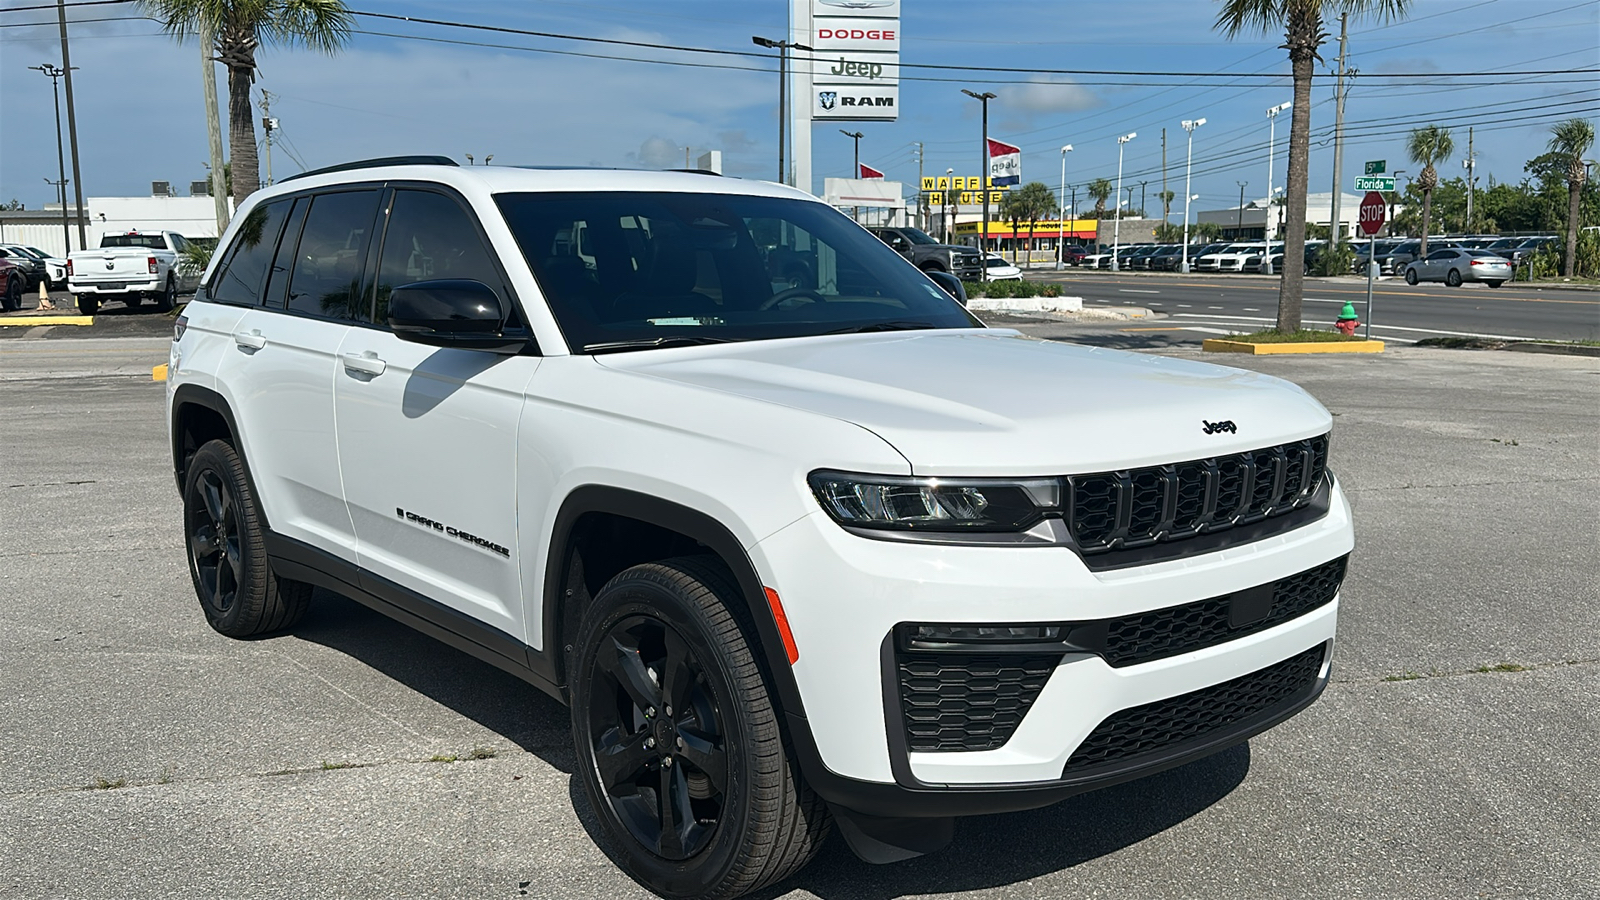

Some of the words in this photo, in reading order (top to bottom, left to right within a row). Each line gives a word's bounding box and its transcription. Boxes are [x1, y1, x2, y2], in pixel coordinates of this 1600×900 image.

[818, 29, 895, 40] DODGE
[831, 57, 882, 80] Jeep
[841, 97, 894, 107] RAM
[923, 178, 1008, 188] WAFF
[1356, 178, 1384, 189] Florida
[932, 193, 1000, 204] HUSE
[1361, 204, 1384, 222] STOP
[1202, 420, 1237, 435] Jeep
[405, 511, 444, 531] GRAND
[445, 526, 510, 558] CHEROKEE
